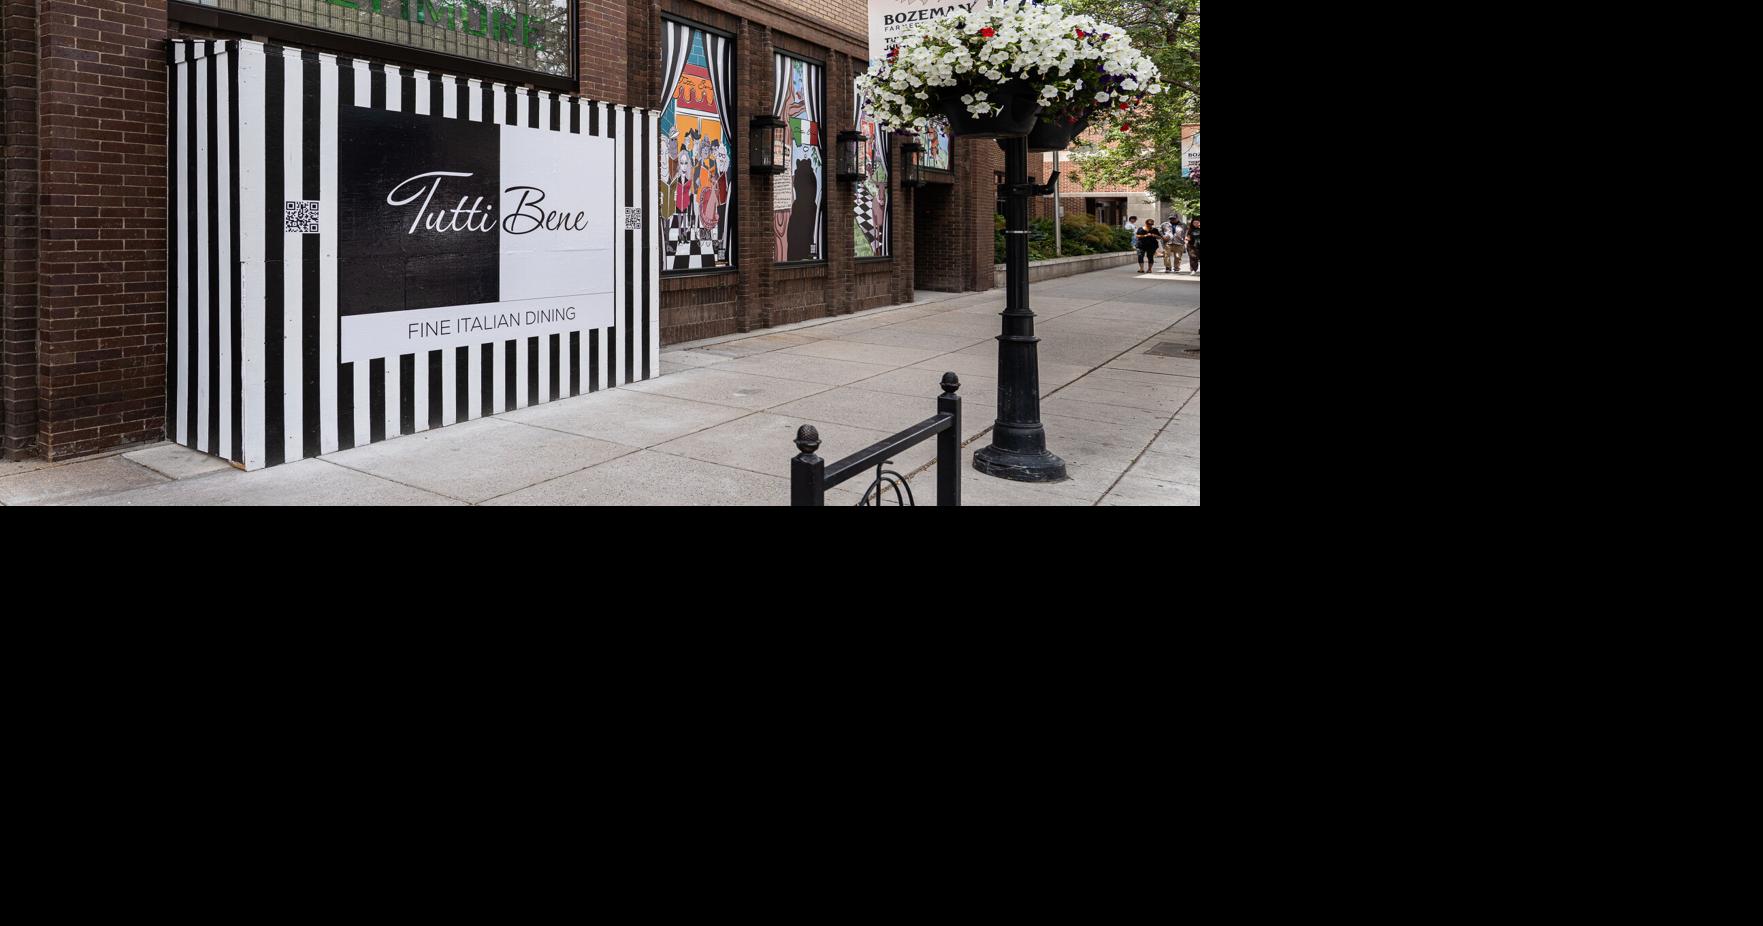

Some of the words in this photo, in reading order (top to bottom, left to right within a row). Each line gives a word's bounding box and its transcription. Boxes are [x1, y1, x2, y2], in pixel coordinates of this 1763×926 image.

[387, 171, 497, 235] Tutti
[502, 185, 589, 235] Bene
[408, 319, 451, 339] FINE
[457, 312, 520, 334] ITALIAN
[525, 306, 576, 326] DINING
